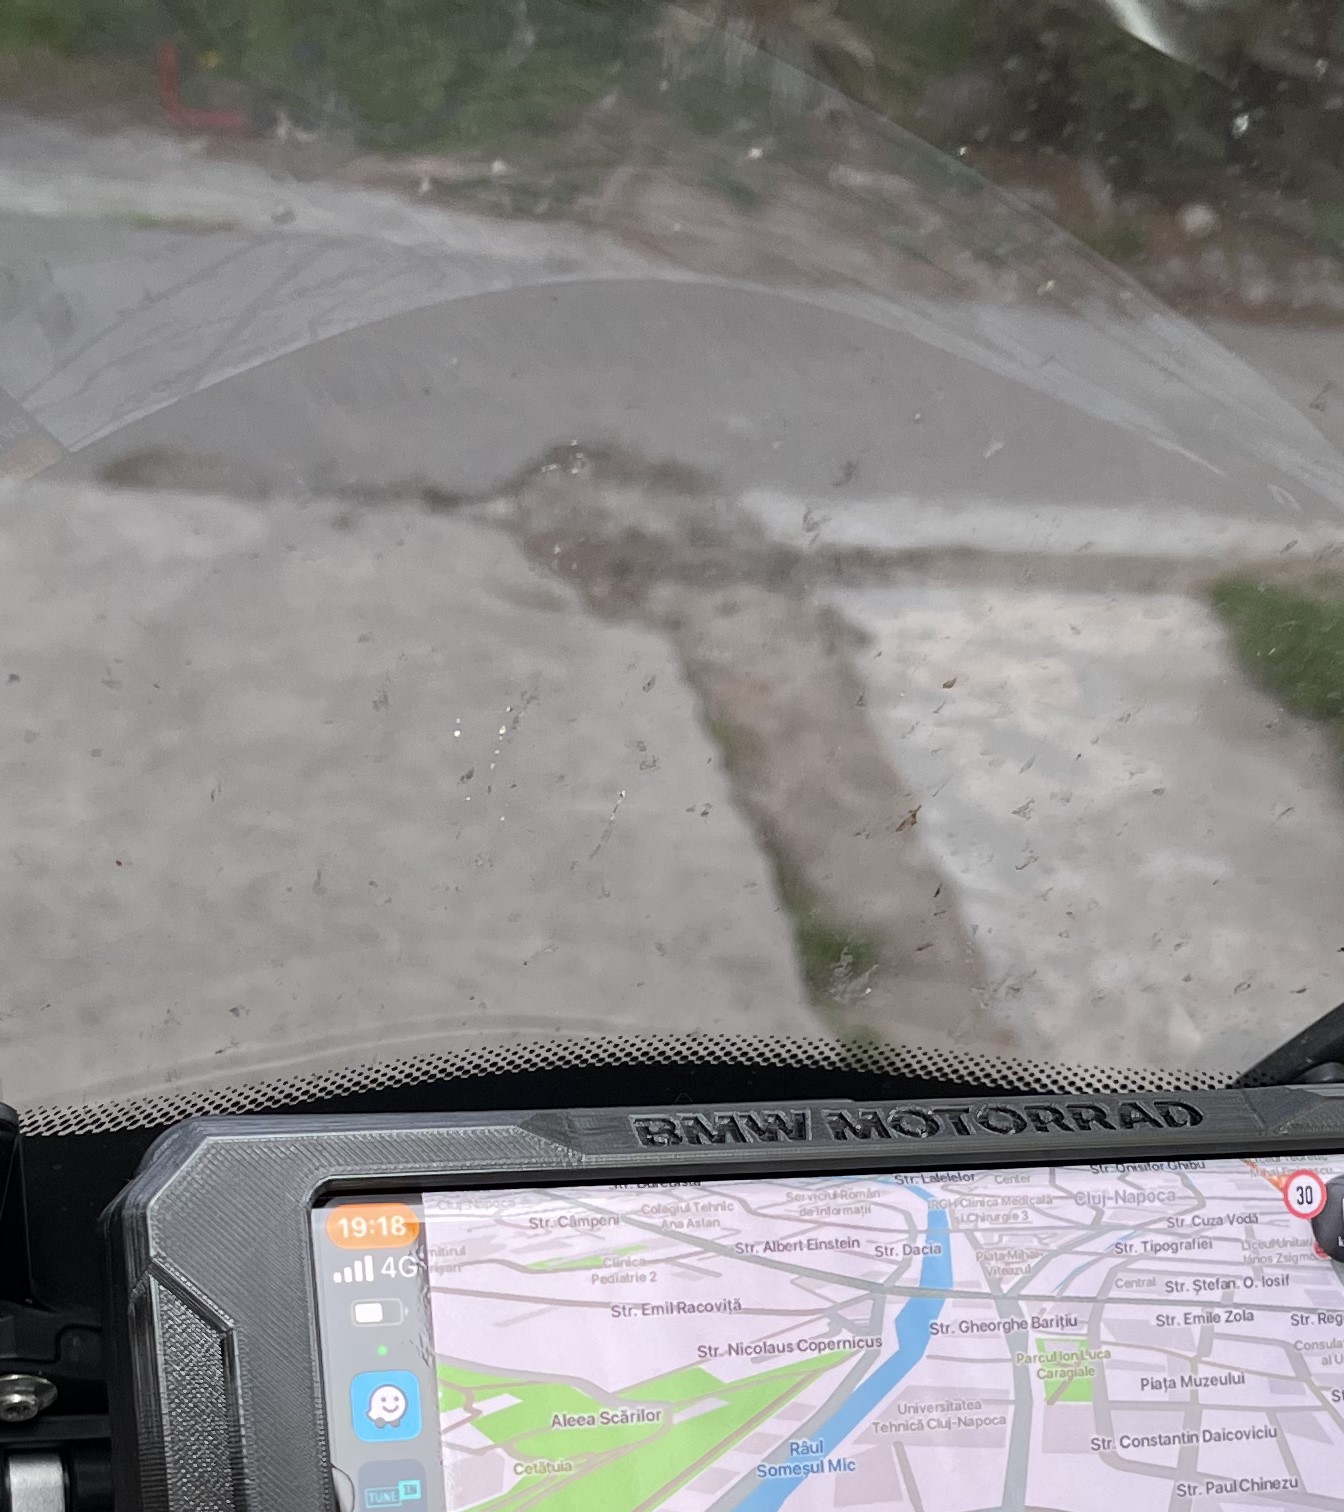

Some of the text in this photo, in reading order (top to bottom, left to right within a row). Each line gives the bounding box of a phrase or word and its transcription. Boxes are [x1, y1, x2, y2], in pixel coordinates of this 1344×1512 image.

[631, 1100, 1204, 1148] BMW MOTORRAD
[895, 1174, 918, 1185] Str.
[1074, 1190, 1176, 1207] Cluj-Napoca
[1296, 1186, 1314, 1206] 30
[692, 1200, 734, 1213] Tehnic
[338, 1215, 407, 1239] 19:18
[529, 1216, 554, 1230] Str.
[1191, 1214, 1224, 1227] Cuza
[736, 1236, 861, 1255] Str. Albert Einstein
[875, 1243, 942, 1258] Str. Dacia
[1115, 1238, 1213, 1255] Str. Tipografiei
[380, 1254, 419, 1279] 4G
[591, 1270, 657, 1285] Pediatrie 2
[1114, 1276, 1156, 1290] Central
[1165, 1280, 1189, 1294] Str.
[1261, 1273, 1290, 1288] Iosif
[611, 1304, 637, 1318] Str.
[641, 1302, 674, 1316] Emil
[1156, 1309, 1255, 1328] Str. Emile Zola
[930, 1321, 956, 1336] Str.
[958, 1318, 1028, 1335] Gheorghe
[1290, 1313, 1315, 1327] Str.
[697, 1335, 883, 1360] Str. Nicolaus Copernicus
[1016, 1350, 1057, 1365] Parcul
[1321, 1354, 1332, 1367] al
[1036, 1365, 1096, 1381] Caragiale
[1180, 1372, 1246, 1389] Muzeului
[897, 1400, 983, 1416] Universitatea
[551, 1407, 662, 1429] Aleea Scărilor
[873, 1415, 1007, 1434] Tehnică Cluj-Napoca
[1091, 1424, 1278, 1451] Str. Constantin Daicoviciu
[789, 1439, 825, 1457] Râul
[828, 1457, 856, 1474] Mic
[1176, 1476, 1299, 1498] Str. Paul Chinezu
